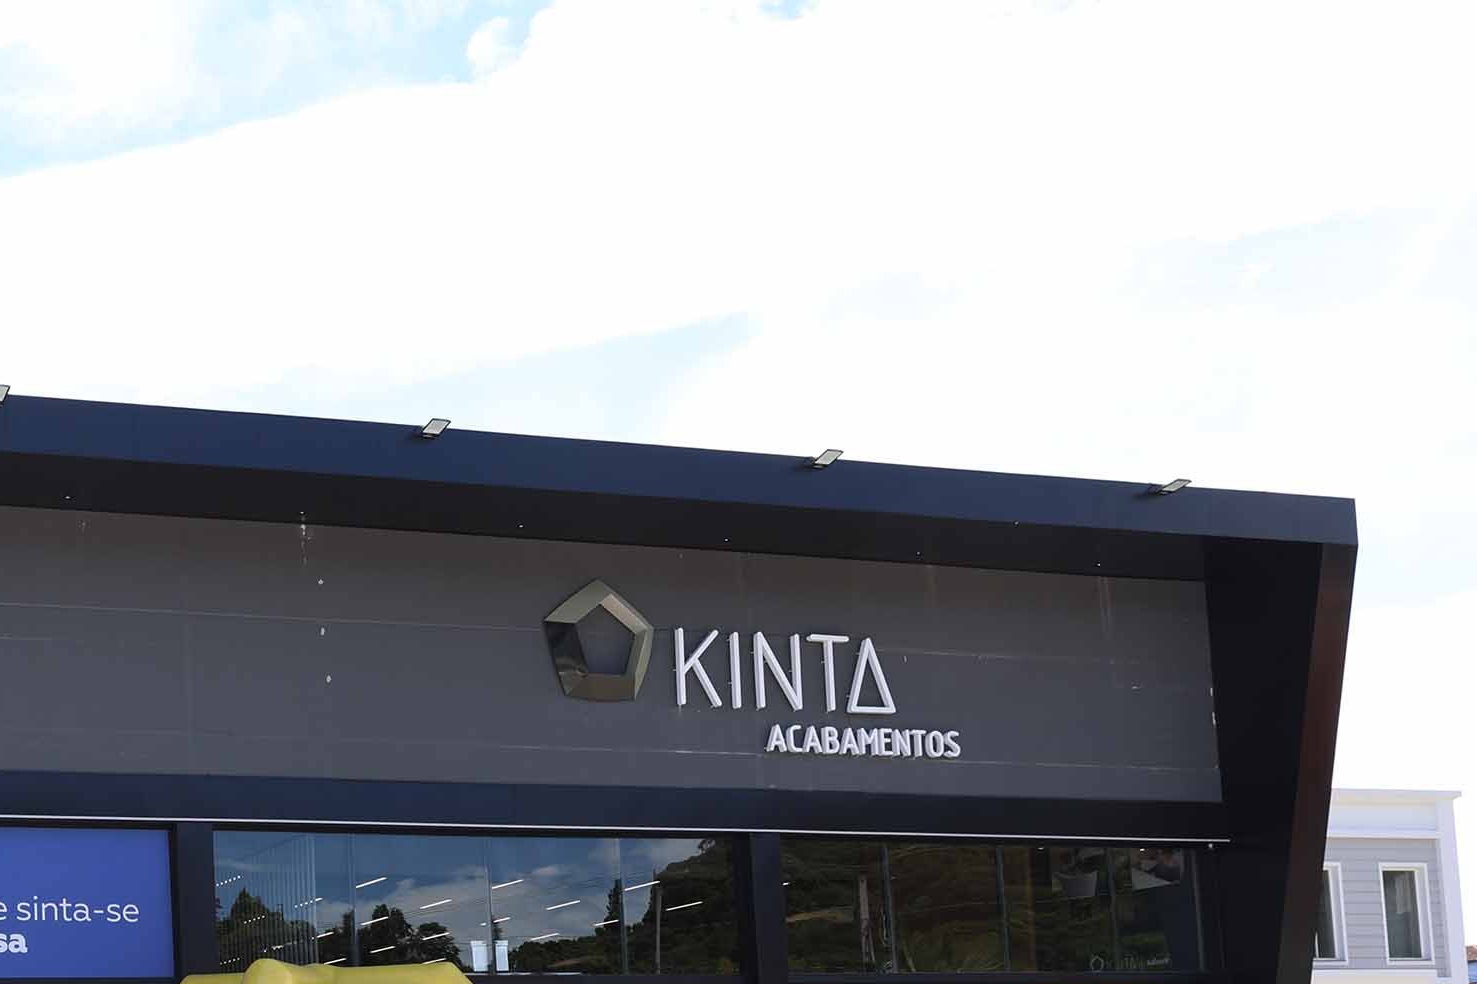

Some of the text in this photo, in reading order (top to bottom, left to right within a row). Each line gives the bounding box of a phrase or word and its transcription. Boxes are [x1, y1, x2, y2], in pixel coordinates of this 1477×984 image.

[674, 627, 897, 714] KINTA
[764, 723, 962, 759] ACABAMENTOS
[16, 895, 140, 923] sinta-se
